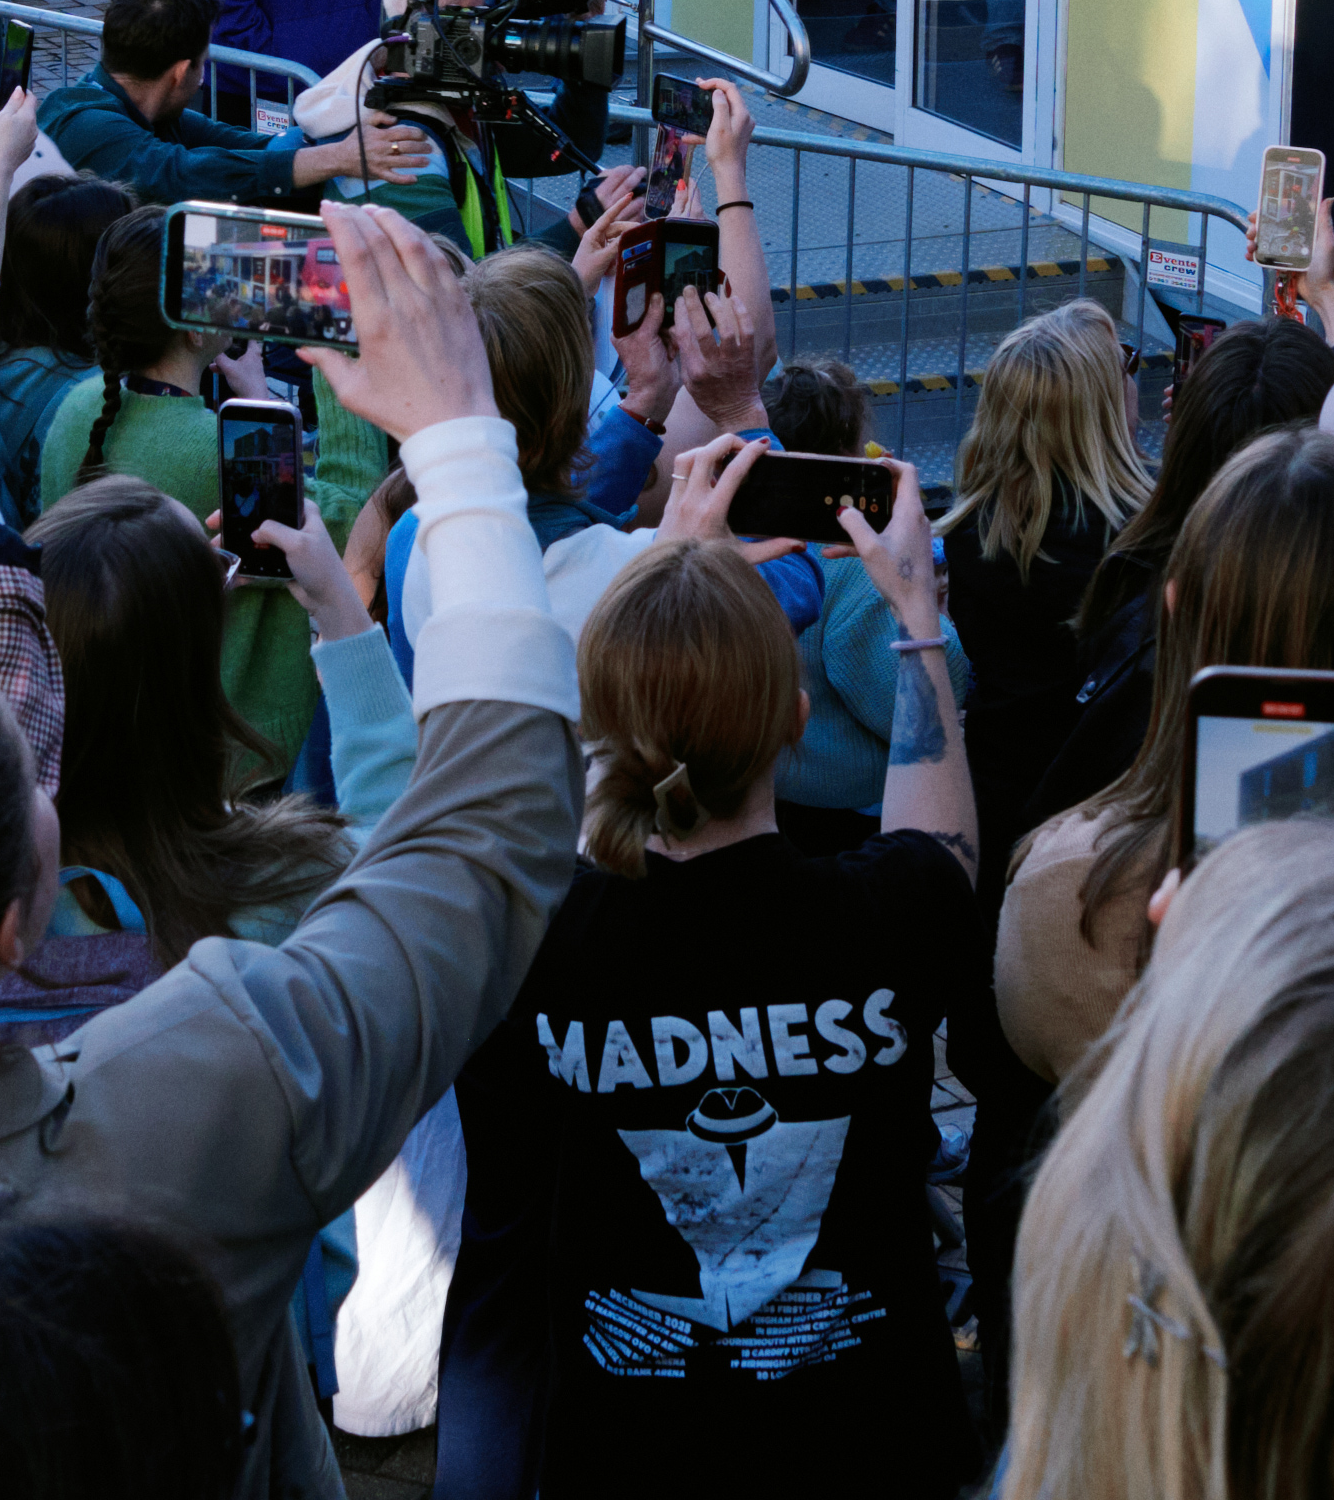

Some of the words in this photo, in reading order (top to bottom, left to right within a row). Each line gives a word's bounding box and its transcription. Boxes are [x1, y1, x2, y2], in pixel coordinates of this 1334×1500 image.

[257, 110, 289, 123] Events
[1150, 252, 1196, 268] Events
[1164, 265, 1196, 275] crew
[535, 987, 908, 1094] MADNESS
[609, 1287, 663, 1324] DECEMBER
[664, 1314, 693, 1336] 2025
[631, 1336, 653, 1355] OVO
[626, 1367, 654, 1377] BANK
[653, 1368, 687, 1379] ARENA
